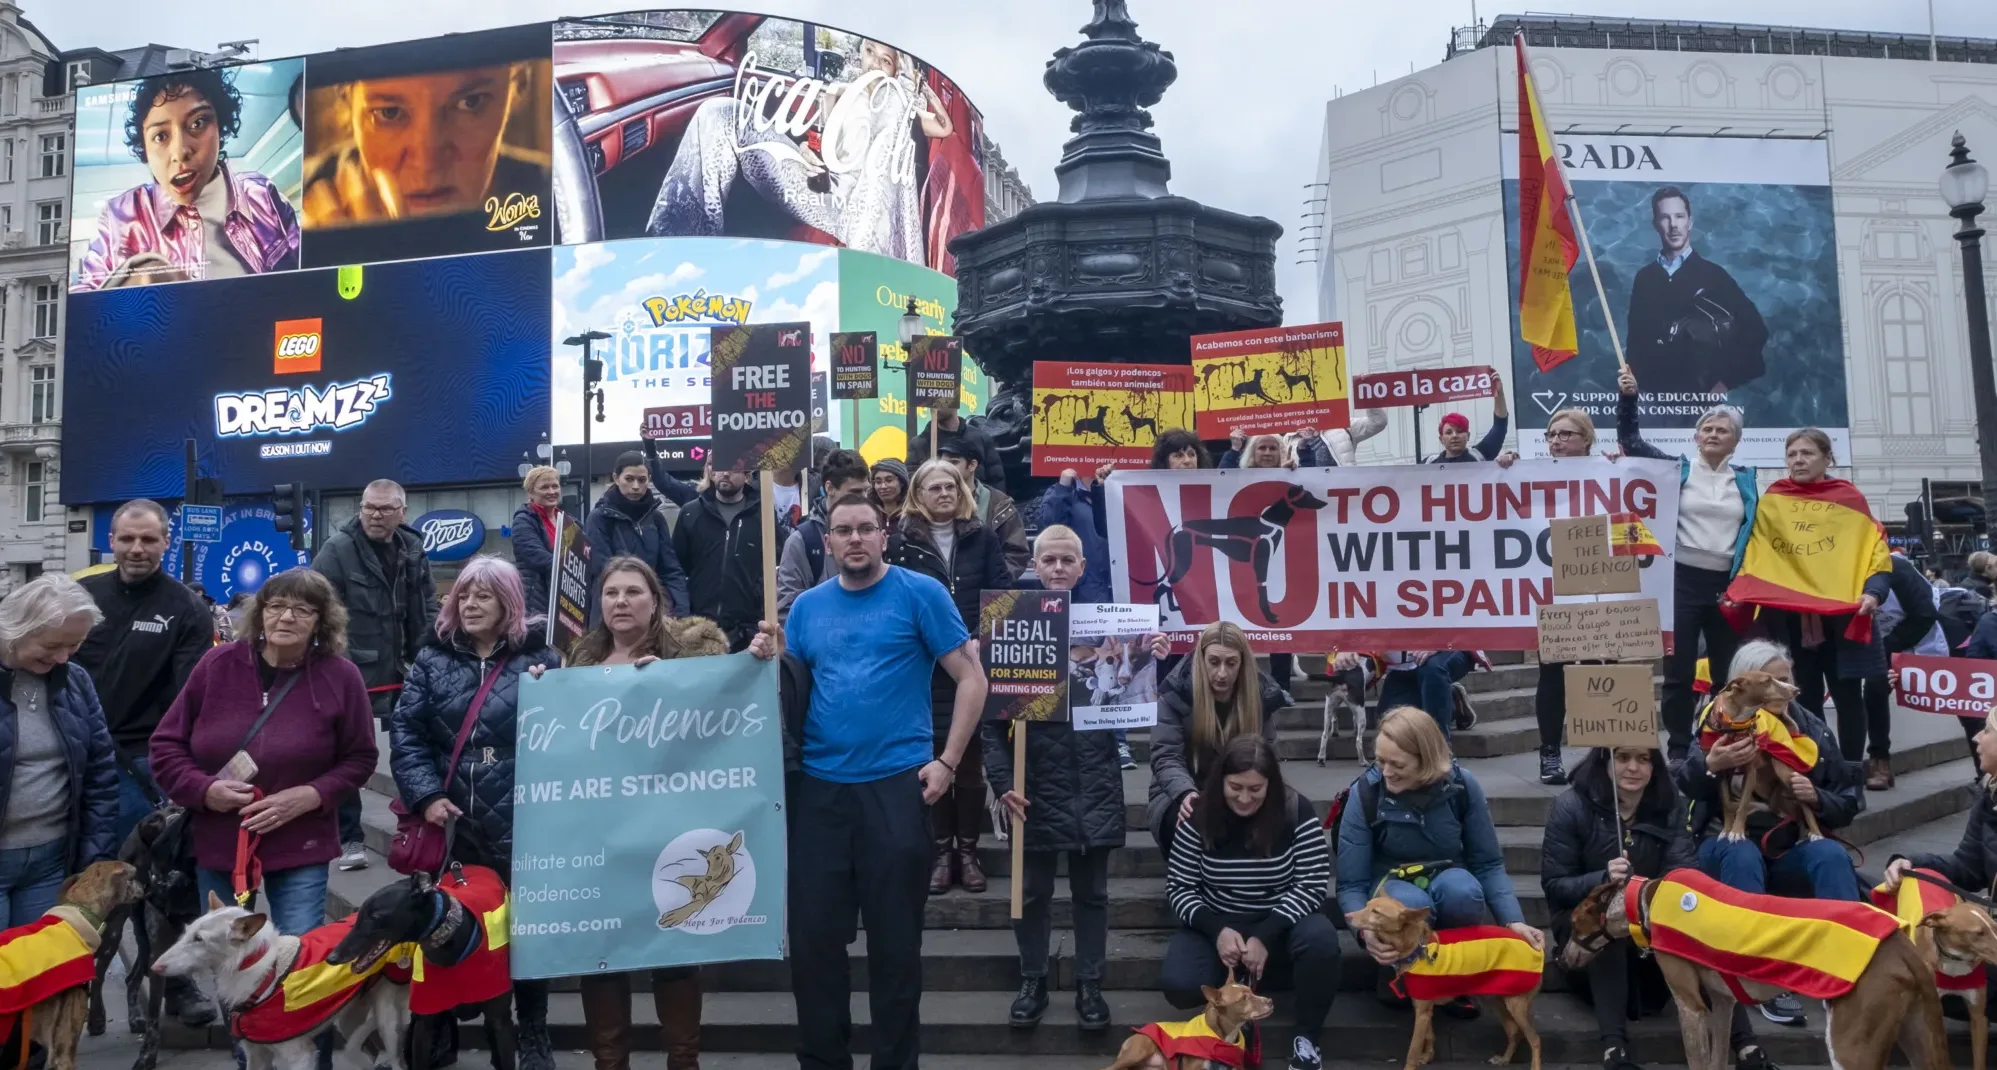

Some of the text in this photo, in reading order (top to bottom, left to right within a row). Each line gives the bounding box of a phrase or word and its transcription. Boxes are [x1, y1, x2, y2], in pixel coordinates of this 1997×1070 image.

[1557, 143, 1663, 170] RADA
[784, 189, 826, 207] Real
[485, 192, 541, 231] Wonka
[278, 335, 319, 357] LEGO
[1196, 330, 1339, 351] Acabemos con este barbarismo
[842, 344, 865, 365] NO
[924, 349, 949, 371] NO
[732, 364, 790, 390] FREE
[855, 372, 871, 380] DOGS
[1067, 367, 1161, 378] ¡Los galgos y podencos
[632, 377, 670, 388] THE
[848, 381, 872, 389] SPAIN
[1071, 379, 1164, 389] también son animales!
[1358, 373, 1492, 399] no a la caza
[745, 392, 776, 408] THE
[916, 388, 954, 397] IN SPAIN
[1573, 392, 1728, 402] SUPPONG EDUCATION
[1284, 410, 1305, 418] perros
[1603, 406, 1646, 415] OCN
[648, 412, 694, 429] no a
[717, 410, 805, 431] PODENCO
[1257, 421, 1273, 429] lugar
[1290, 418, 1306, 426] siglo
[649, 427, 693, 438] con perros
[262, 444, 290, 456] SEASON
[295, 443, 310, 454] OUT
[312, 441, 330, 453] NOW
[672, 451, 684, 459] on
[1119, 456, 1127, 464] de
[1789, 501, 1836, 513] STOP
[421, 516, 474, 552] Boots
[1568, 524, 1605, 540] FREE
[1791, 521, 1816, 532] THE
[1122, 477, 1659, 629] NO TO HUNTING
[1327, 528, 1485, 572] WITH
[1574, 545, 1600, 558] THE
[1771, 535, 1837, 556] CRUELTY
[221, 540, 279, 583] PICCADILL
[563, 546, 587, 587] LEGAL
[561, 570, 586, 608] RIGHTS
[1328, 576, 1553, 619] IN SPAIN
[1097, 605, 1132, 613] Sultan
[1540, 609, 1571, 622] Every
[1577, 608, 1600, 620] year
[132, 620, 163, 633] PUMA
[991, 619, 1057, 642] LEGAL
[1577, 620, 1611, 632] Galgos
[1620, 617, 1640, 626] and
[1169, 632, 1195, 642] ding
[1542, 634, 1587, 644] Podencos
[1615, 627, 1659, 639] discarded
[991, 644, 1057, 665] RIGHTS
[1556, 645, 1577, 653] Spain
[1582, 643, 1600, 652] after
[1622, 640, 1655, 648] hunting
[990, 668, 1057, 680] FOR SPANISH
[1902, 666, 1995, 699] no a
[992, 684, 1055, 694] HUNTING DOGS
[1587, 676, 1616, 693] NO
[1612, 697, 1638, 714] TO
[1904, 694, 1992, 714] con perros
[516, 698, 767, 756] For Podencos
[1573, 710, 1656, 736] HUNTING!
[514, 766, 757, 805] ER WE ARE STRONGER
[512, 848, 605, 872] bilitate and
[519, 884, 601, 904] Podencos
[509, 916, 622, 936] dencos.com
[684, 915, 766, 930] Hope For Podencos
